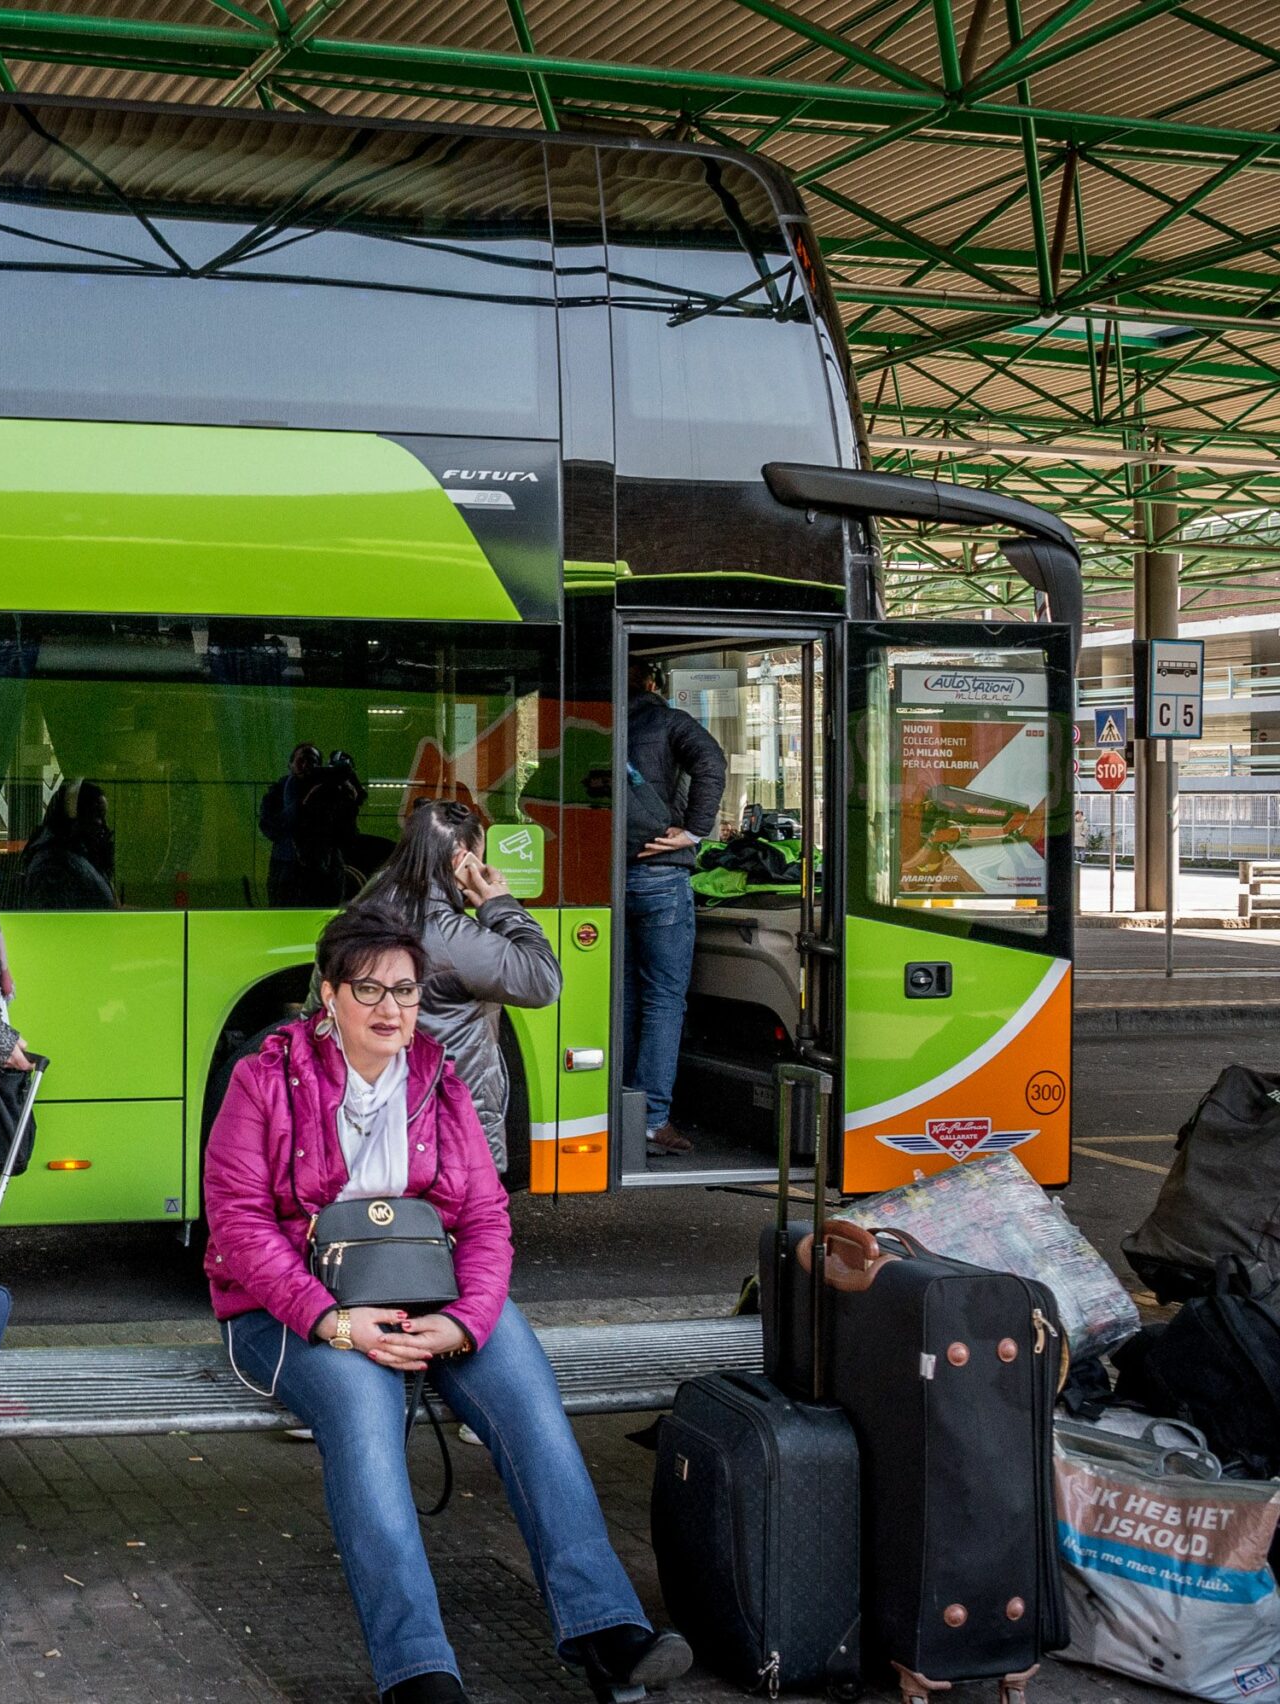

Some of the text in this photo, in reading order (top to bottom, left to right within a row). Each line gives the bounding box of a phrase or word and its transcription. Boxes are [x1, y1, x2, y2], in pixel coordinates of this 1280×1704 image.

[442, 469, 539, 482] FUTURA
[1159, 703, 1194, 727] C 5
[903, 725, 933, 734] NUOVI
[903, 737, 967, 746] COLLEGAMENTI
[903, 748, 953, 757] DA MILANO
[903, 760, 980, 769] PER LA CALABRIA
[1097, 764, 1125, 779] STOP
[1031, 1084, 1062, 1101] 300
[1094, 1486, 1235, 1531] IK HEB HET
[1101, 1552, 1124, 1566] me
[1126, 1560, 1157, 1576] mee
